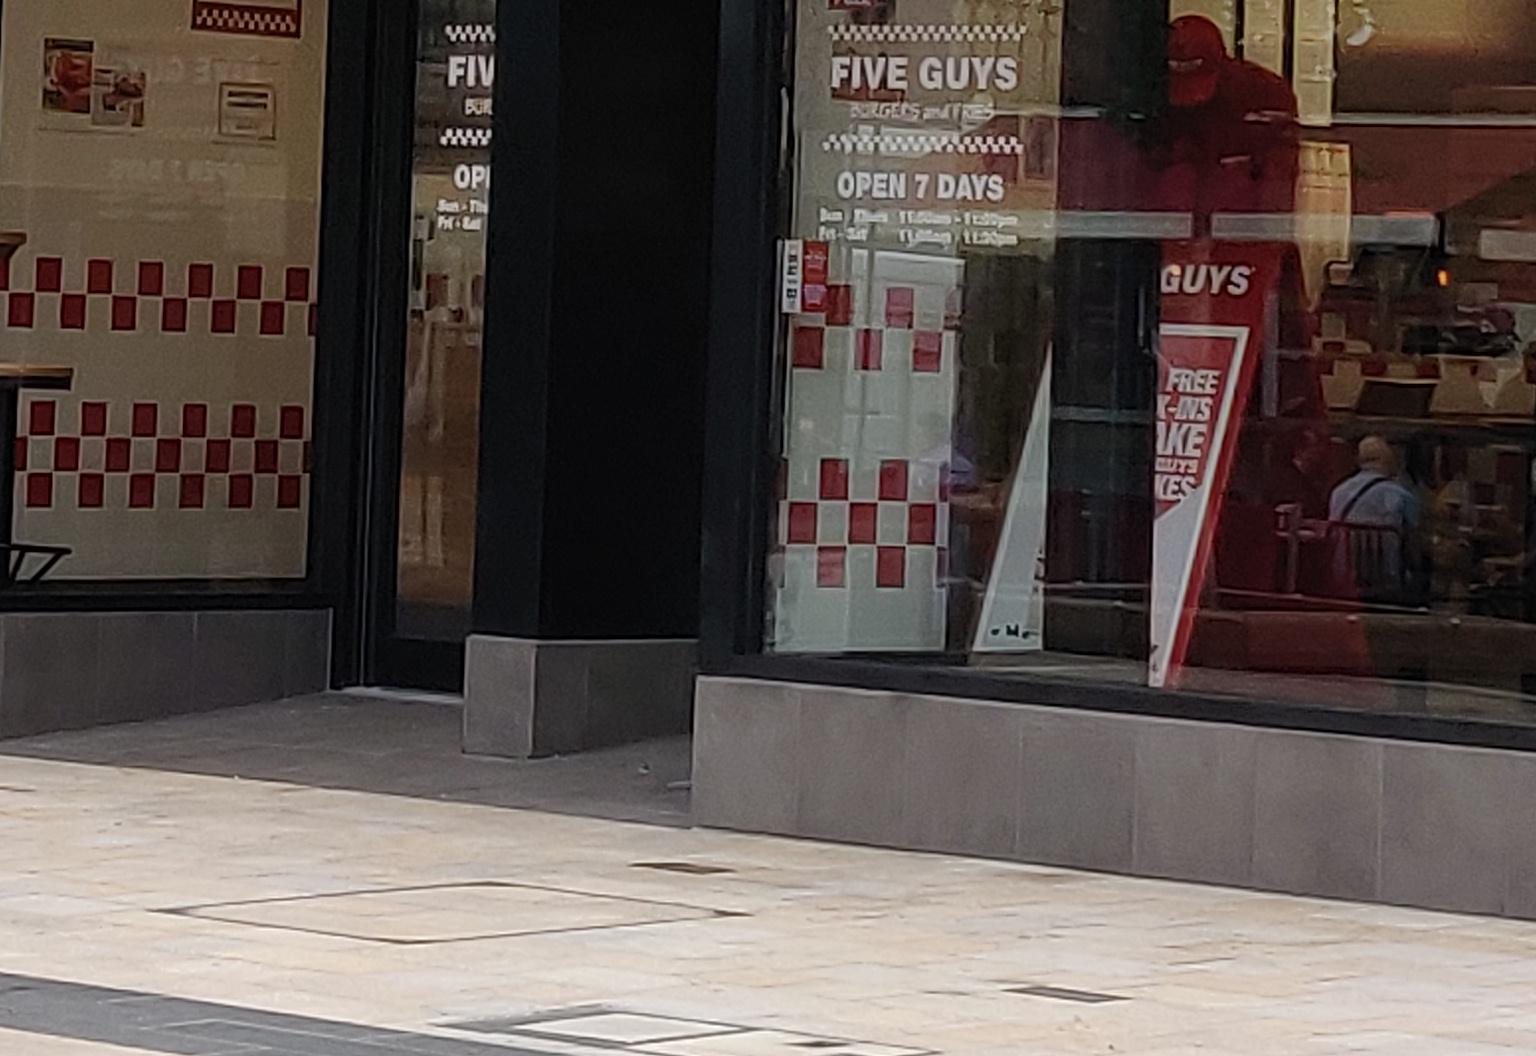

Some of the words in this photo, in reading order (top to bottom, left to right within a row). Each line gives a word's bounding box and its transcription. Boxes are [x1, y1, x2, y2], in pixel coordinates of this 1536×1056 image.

[831, 56, 909, 90] FIVE
[919, 56, 1018, 91] GUYS
[838, 170, 907, 199] OPEN
[915, 174, 930, 200] 7
[937, 174, 1005, 201] DAYS
[1161, 264, 1251, 295] GUYS
[1168, 368, 1222, 395] FREE
